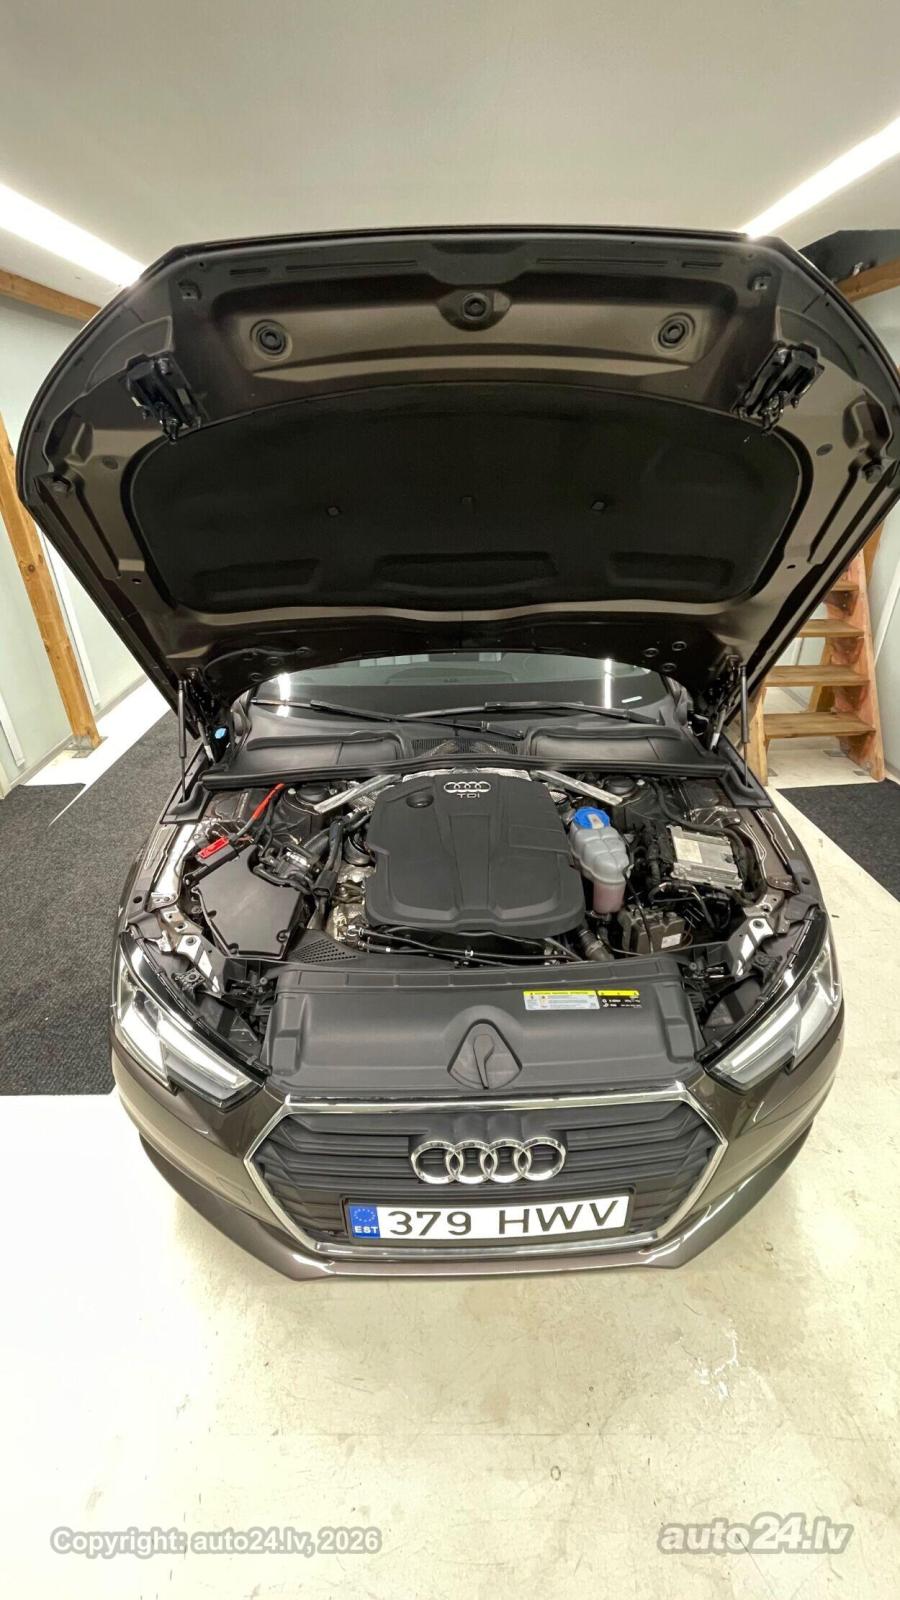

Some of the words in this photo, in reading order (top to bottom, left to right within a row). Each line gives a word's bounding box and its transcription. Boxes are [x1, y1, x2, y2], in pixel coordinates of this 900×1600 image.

[388, 1210, 472, 1236] 379
[499, 1200, 619, 1234] HWV
[354, 1225, 378, 1234] EST
